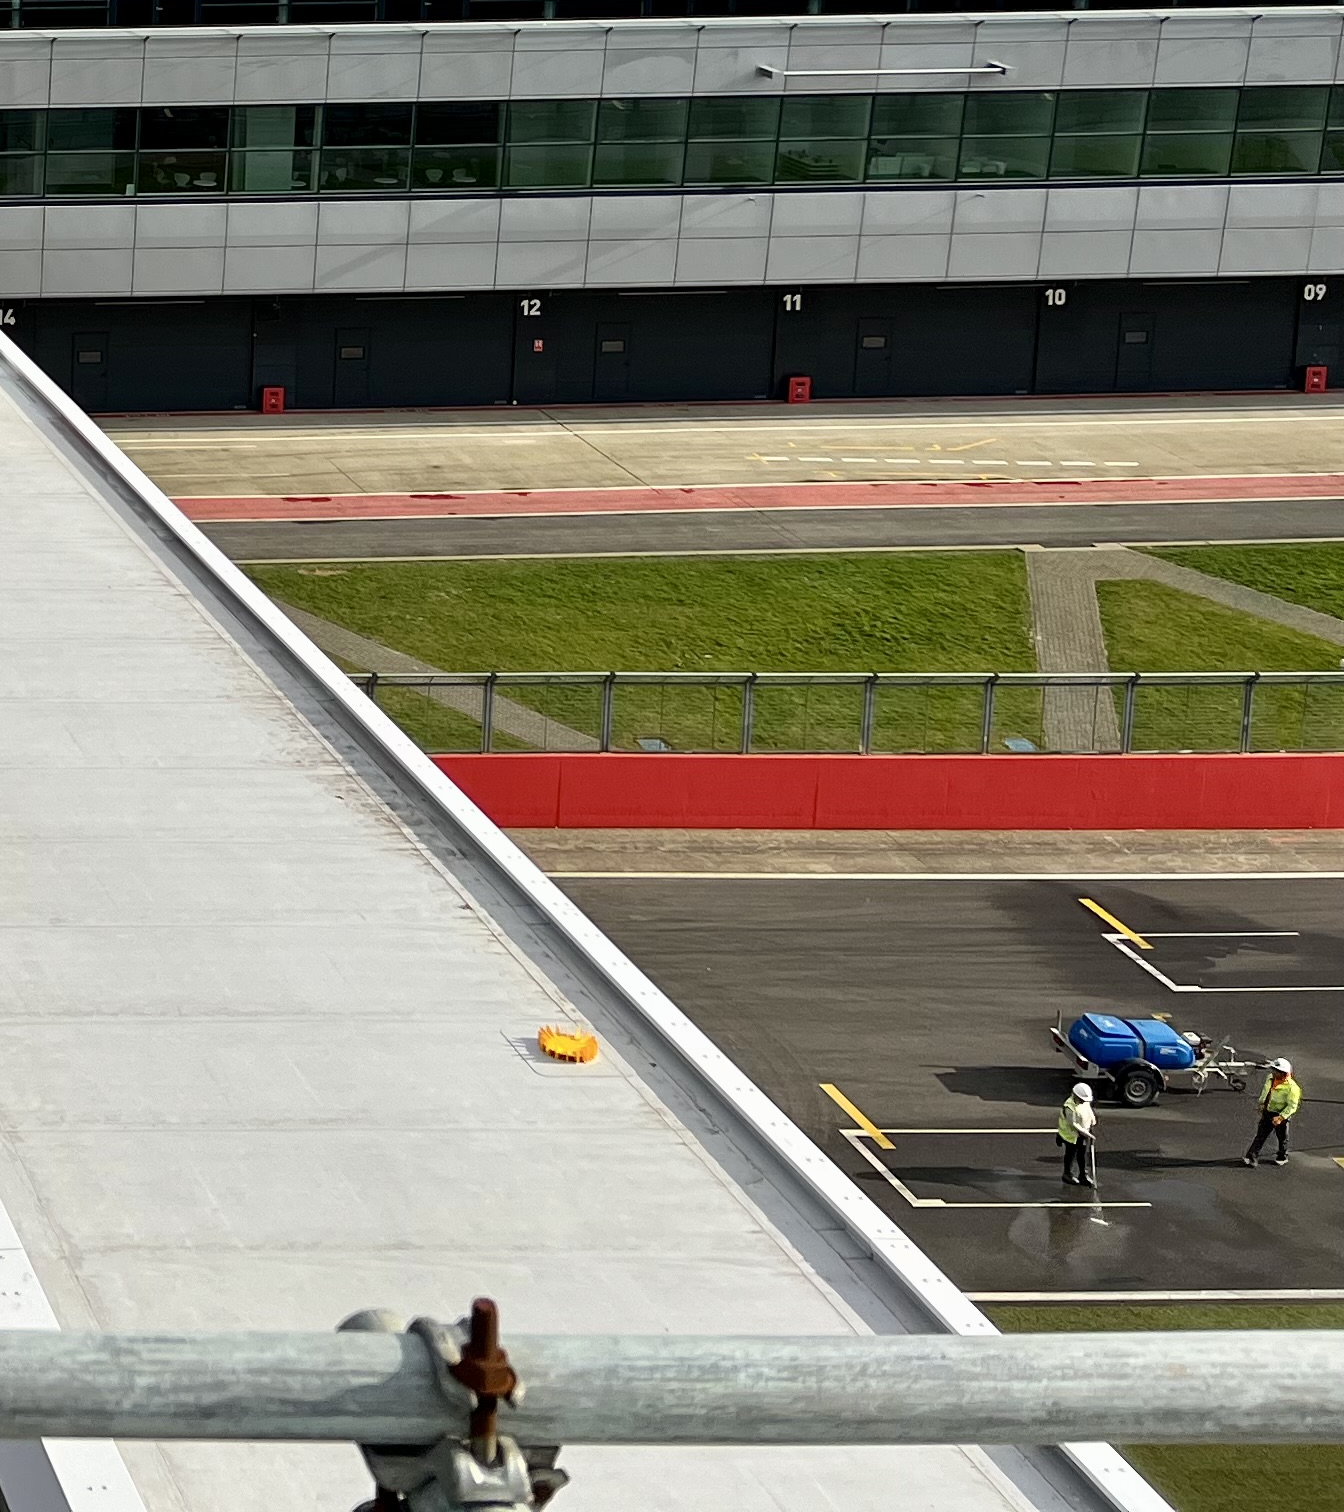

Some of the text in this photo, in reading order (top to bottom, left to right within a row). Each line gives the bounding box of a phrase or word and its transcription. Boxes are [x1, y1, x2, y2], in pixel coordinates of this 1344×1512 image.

[1045, 289, 1066, 305] 10
[1303, 284, 1327, 300] 09
[520, 299, 541, 316] 12
[783, 294, 802, 311] 11
